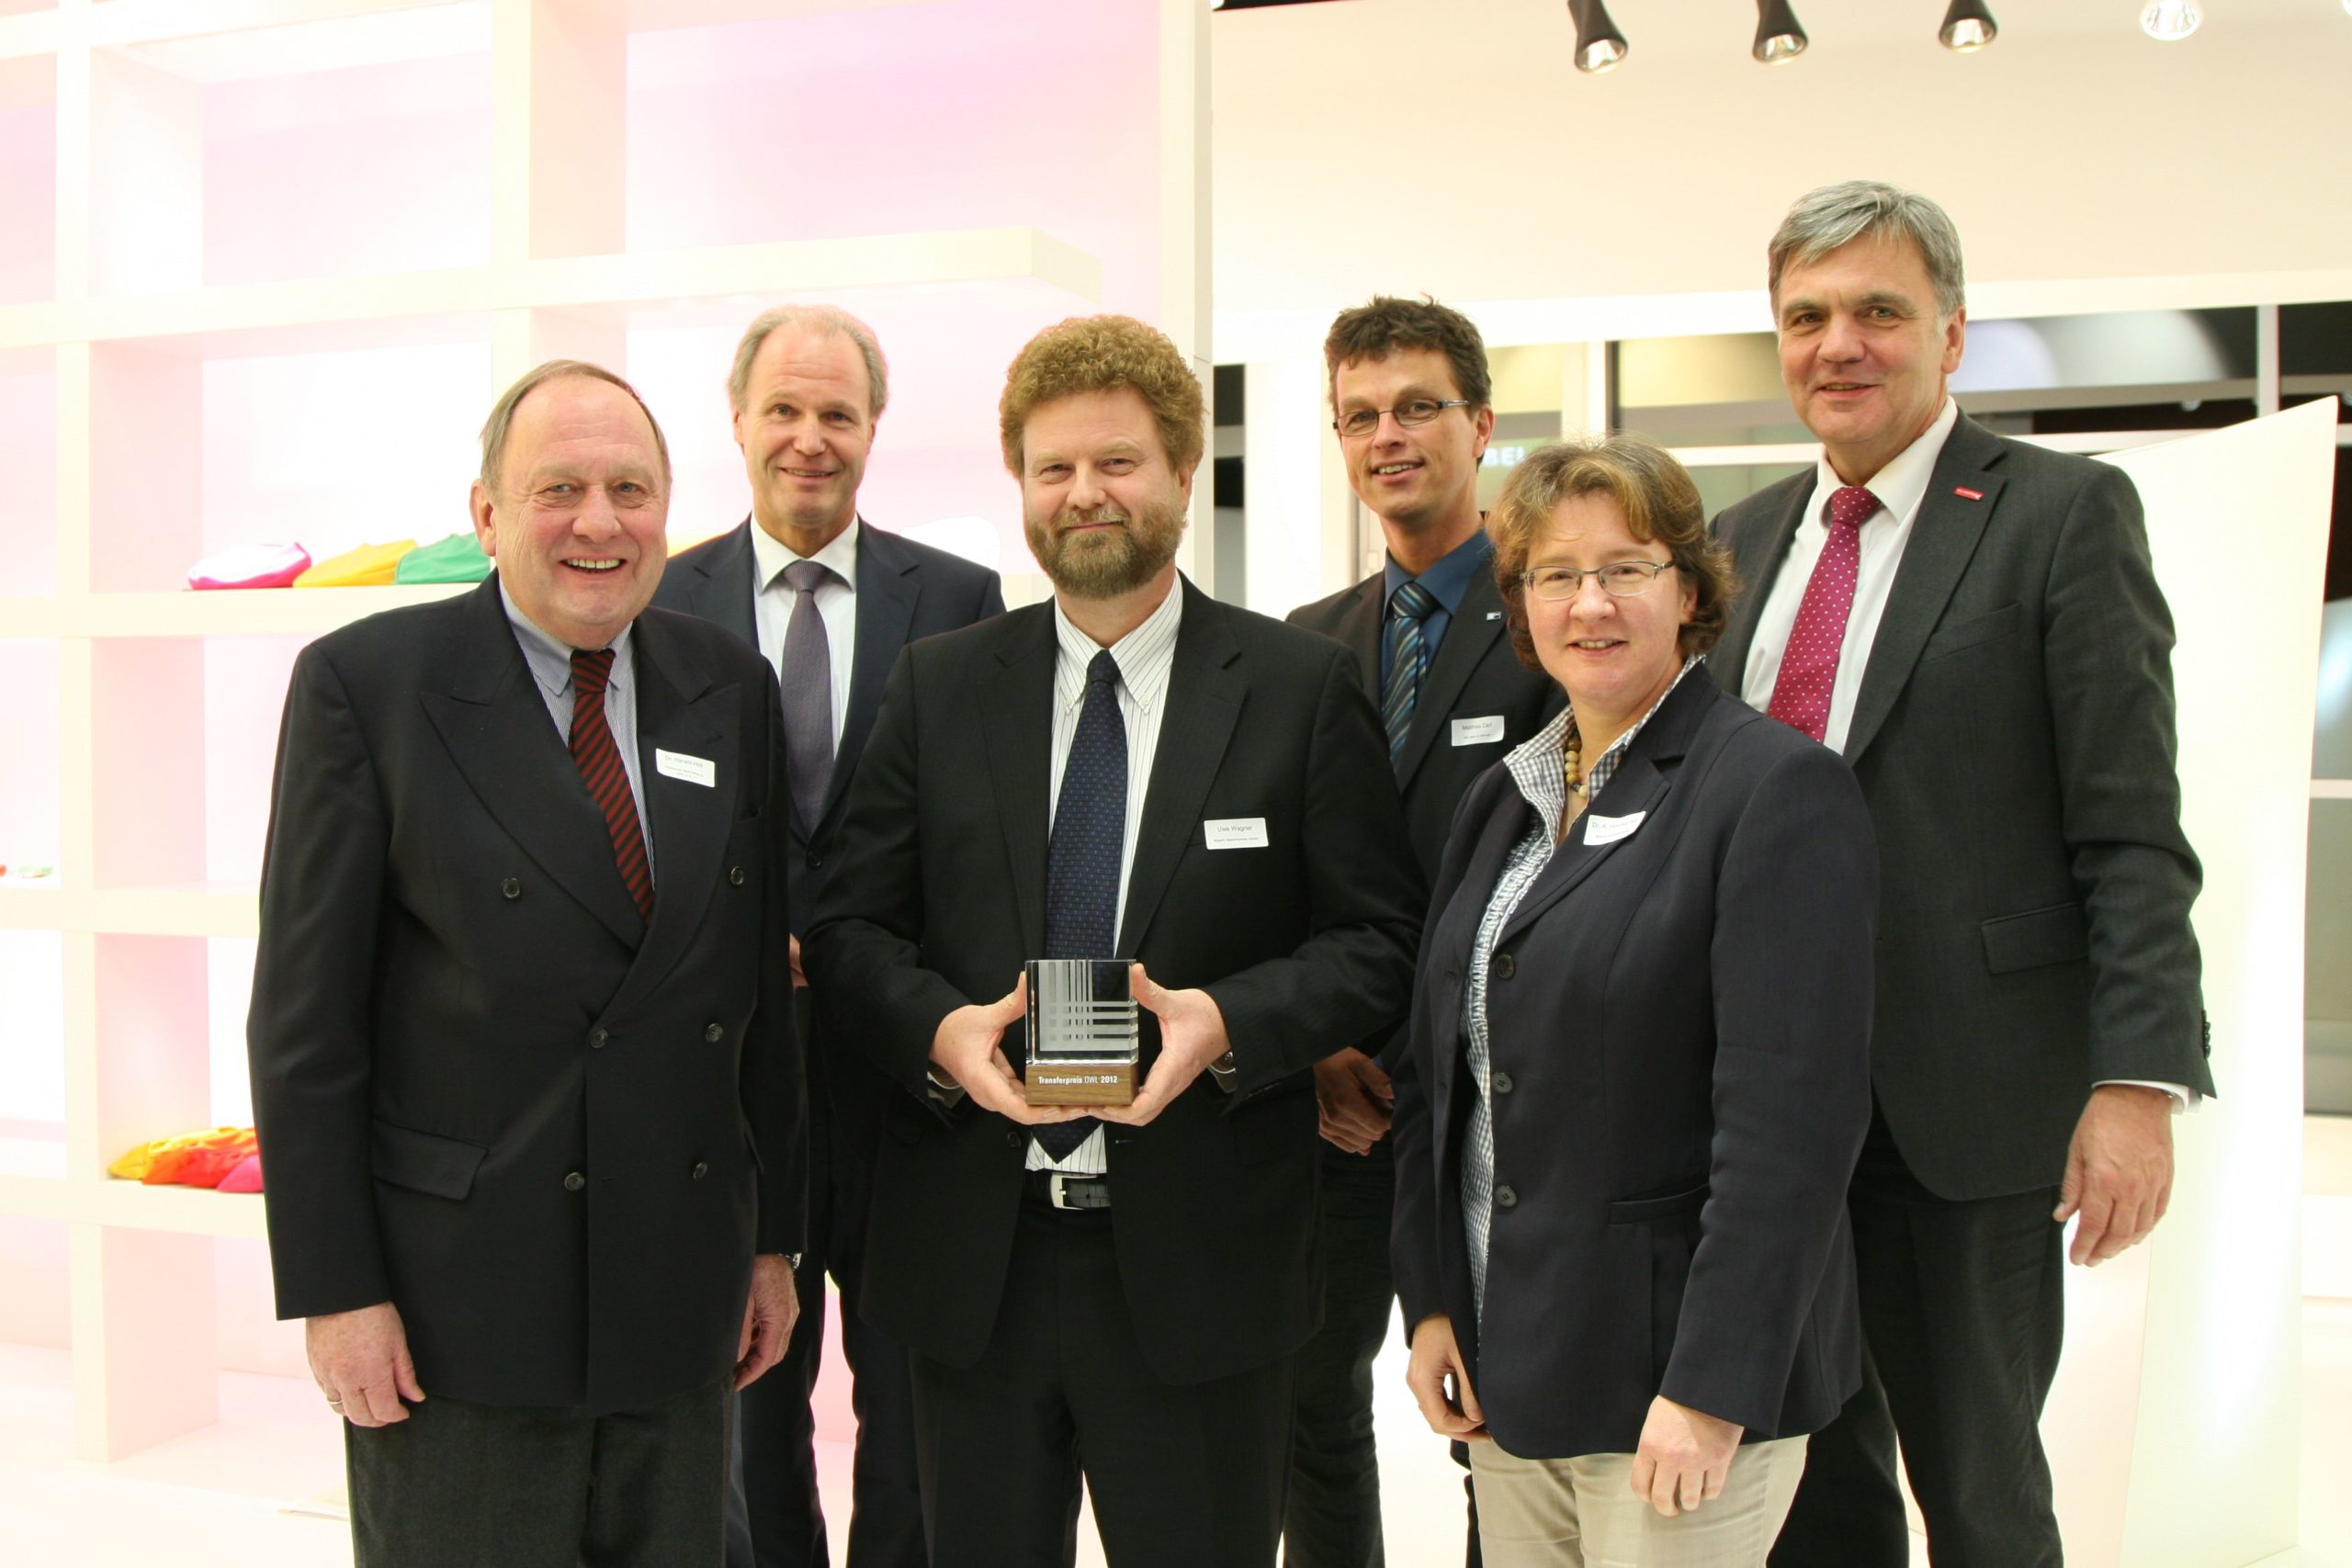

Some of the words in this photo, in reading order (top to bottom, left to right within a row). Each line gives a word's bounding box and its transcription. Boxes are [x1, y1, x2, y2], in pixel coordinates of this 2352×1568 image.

[1231, 824, 1253, 832] Wagner
[1037, 1075, 1083, 1086] Transferpreis
[1083, 1075, 1099, 1084] OWL
[1100, 1075, 1118, 1084] 2012
